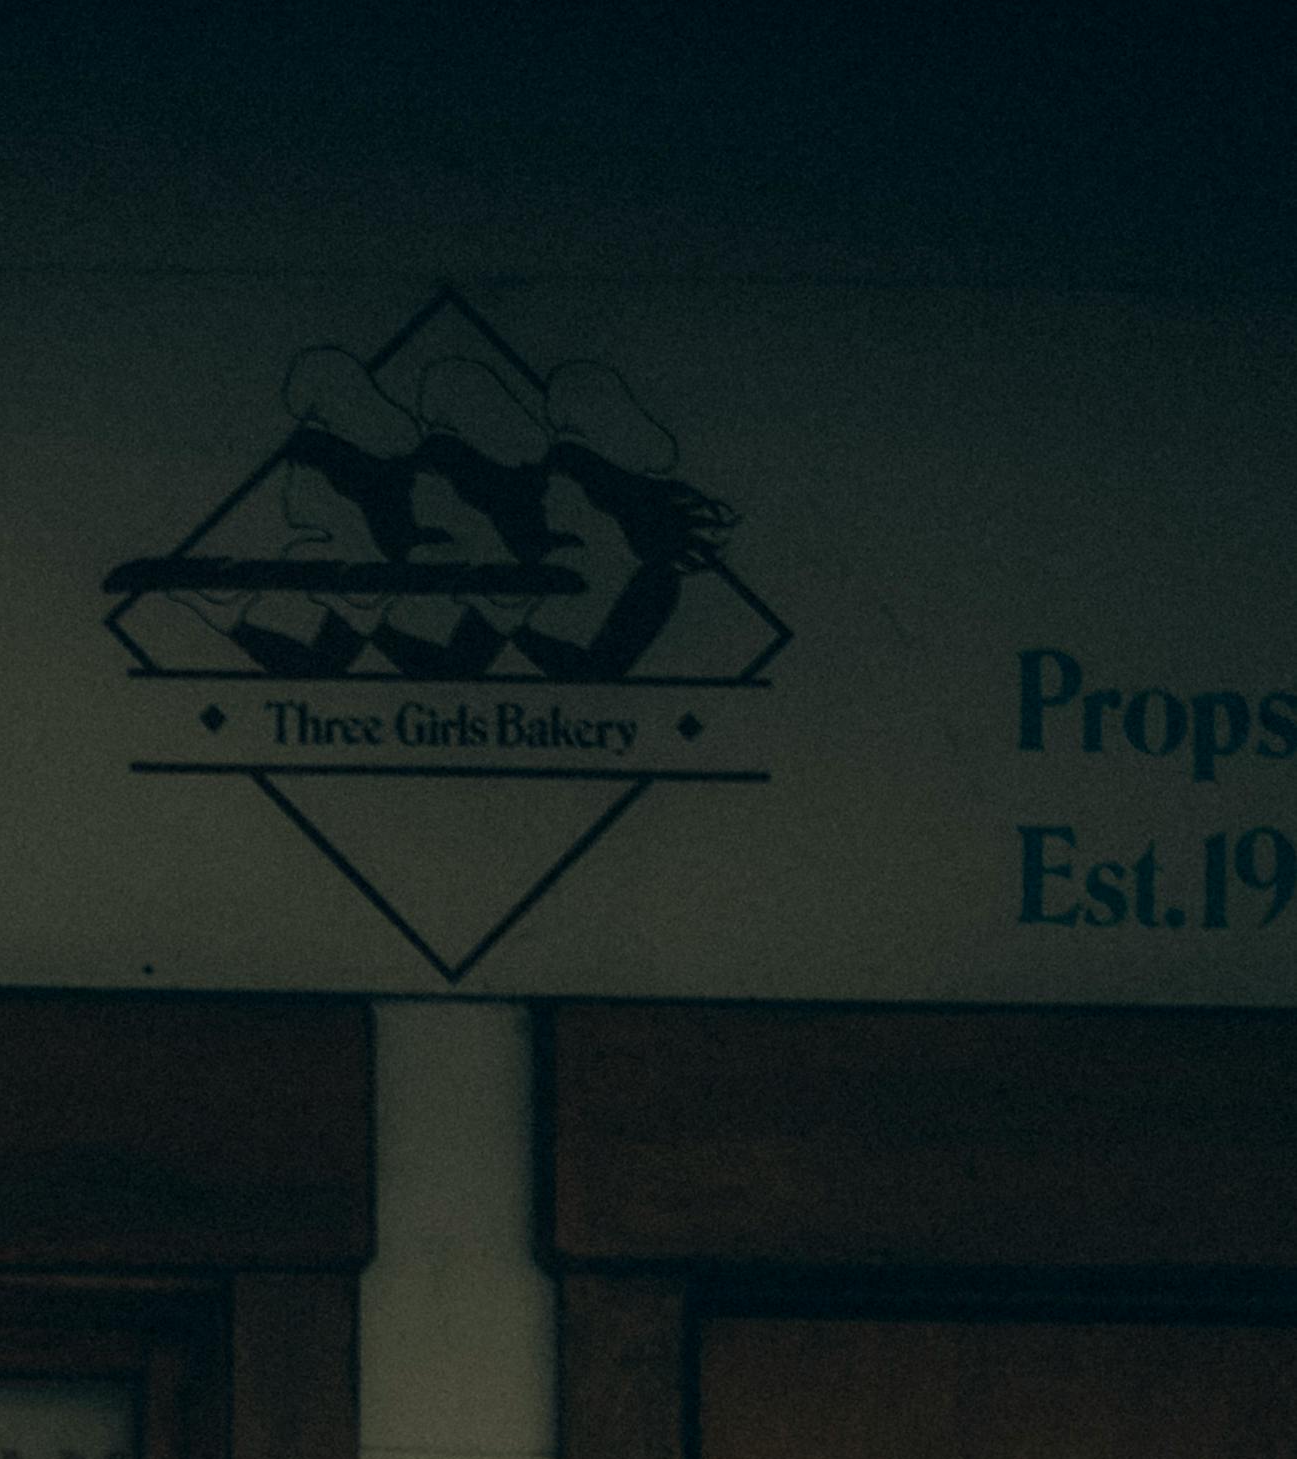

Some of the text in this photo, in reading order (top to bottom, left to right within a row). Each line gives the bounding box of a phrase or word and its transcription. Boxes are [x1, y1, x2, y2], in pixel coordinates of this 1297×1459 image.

[264, 700, 638, 756] Three Girls Bakery
